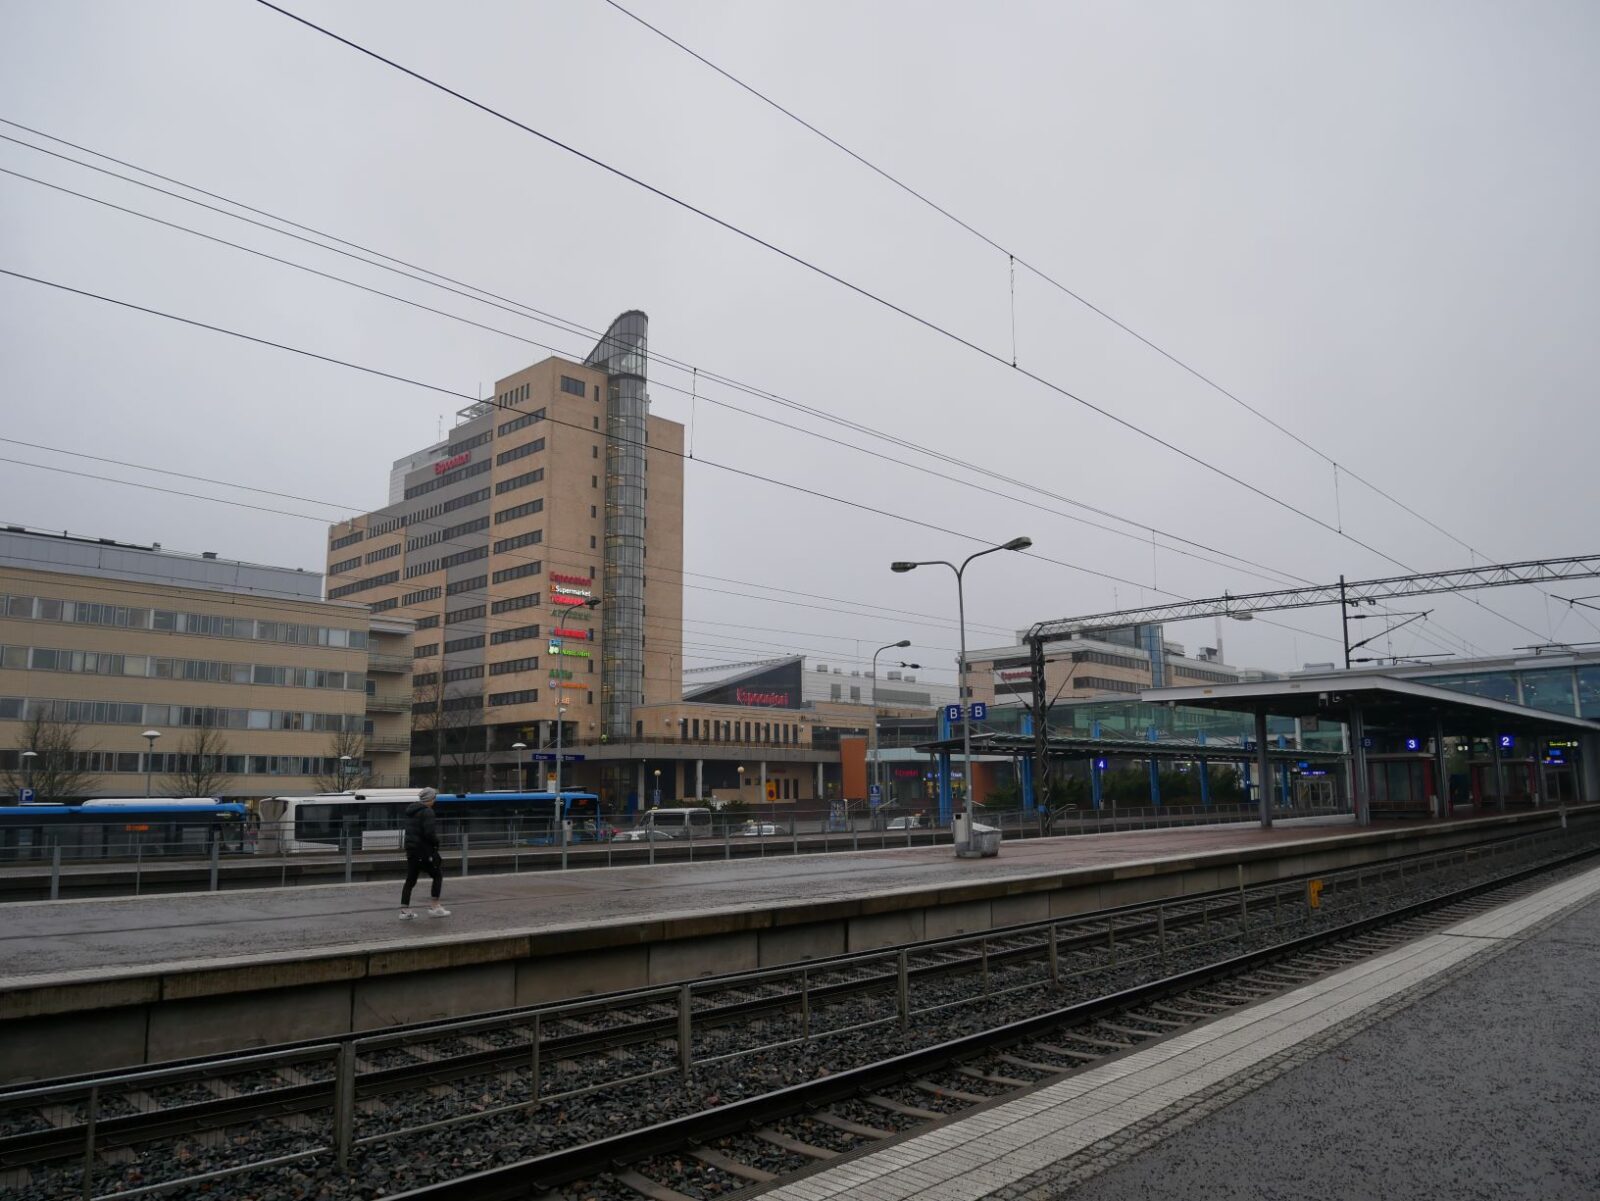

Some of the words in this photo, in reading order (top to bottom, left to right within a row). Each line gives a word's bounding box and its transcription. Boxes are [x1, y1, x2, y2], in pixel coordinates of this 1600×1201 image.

[950, 708, 958, 719] B
[974, 706, 983, 717] B
[1408, 739, 1416, 749] 3
[1502, 736, 1510, 746] 2
[1098, 760, 1105, 769] 4
[21, 789, 33, 801] P
